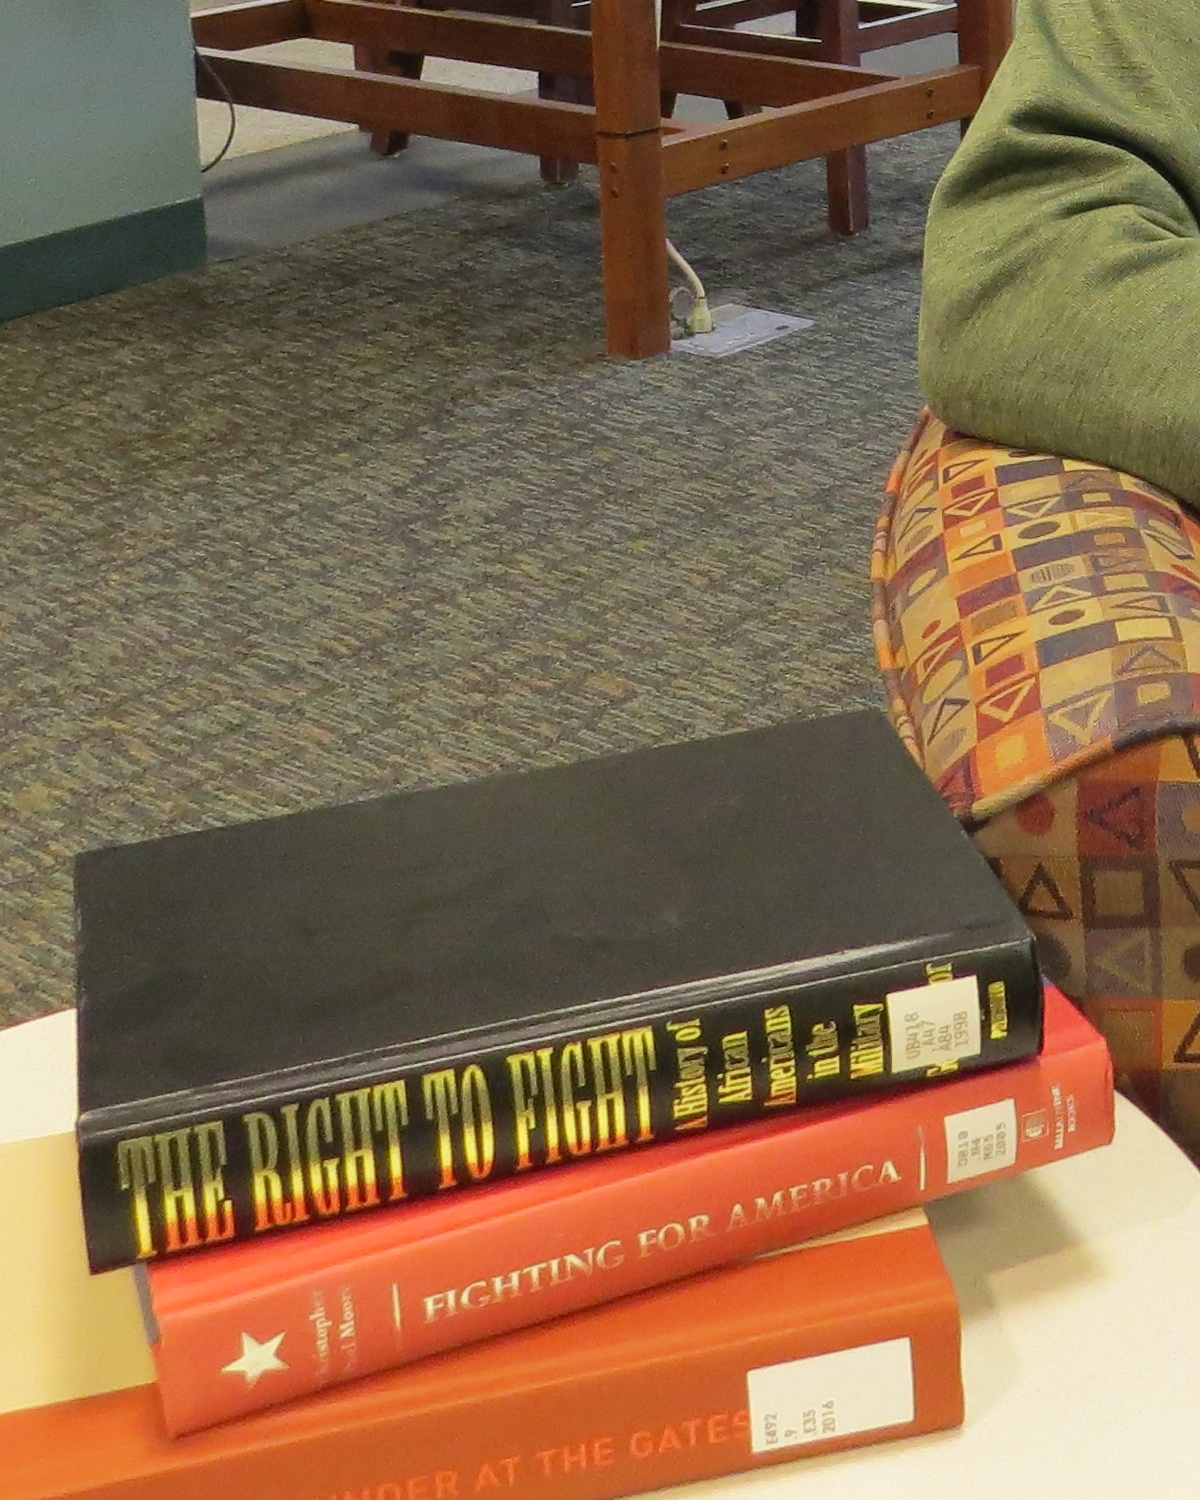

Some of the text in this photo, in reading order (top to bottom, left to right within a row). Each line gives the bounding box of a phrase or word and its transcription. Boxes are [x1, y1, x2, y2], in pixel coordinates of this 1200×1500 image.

[666, 1018, 708, 1131] A History of
[717, 1031, 752, 1104] African
[761, 1005, 797, 1106] Americans
[806, 1020, 840, 1079] in the
[850, 1003, 884, 1080] Military
[904, 1012, 922, 1060] UB418
[118, 1026, 656, 1258] THE RIGHT TO FIGHT
[423, 1160, 902, 1324] FIGHTING FOR AMERICA
[476, 1455, 521, 1491] AT
[537, 1435, 615, 1476] THE
[629, 1409, 749, 1457] GATES
[821, 1400, 836, 1433] 2016
